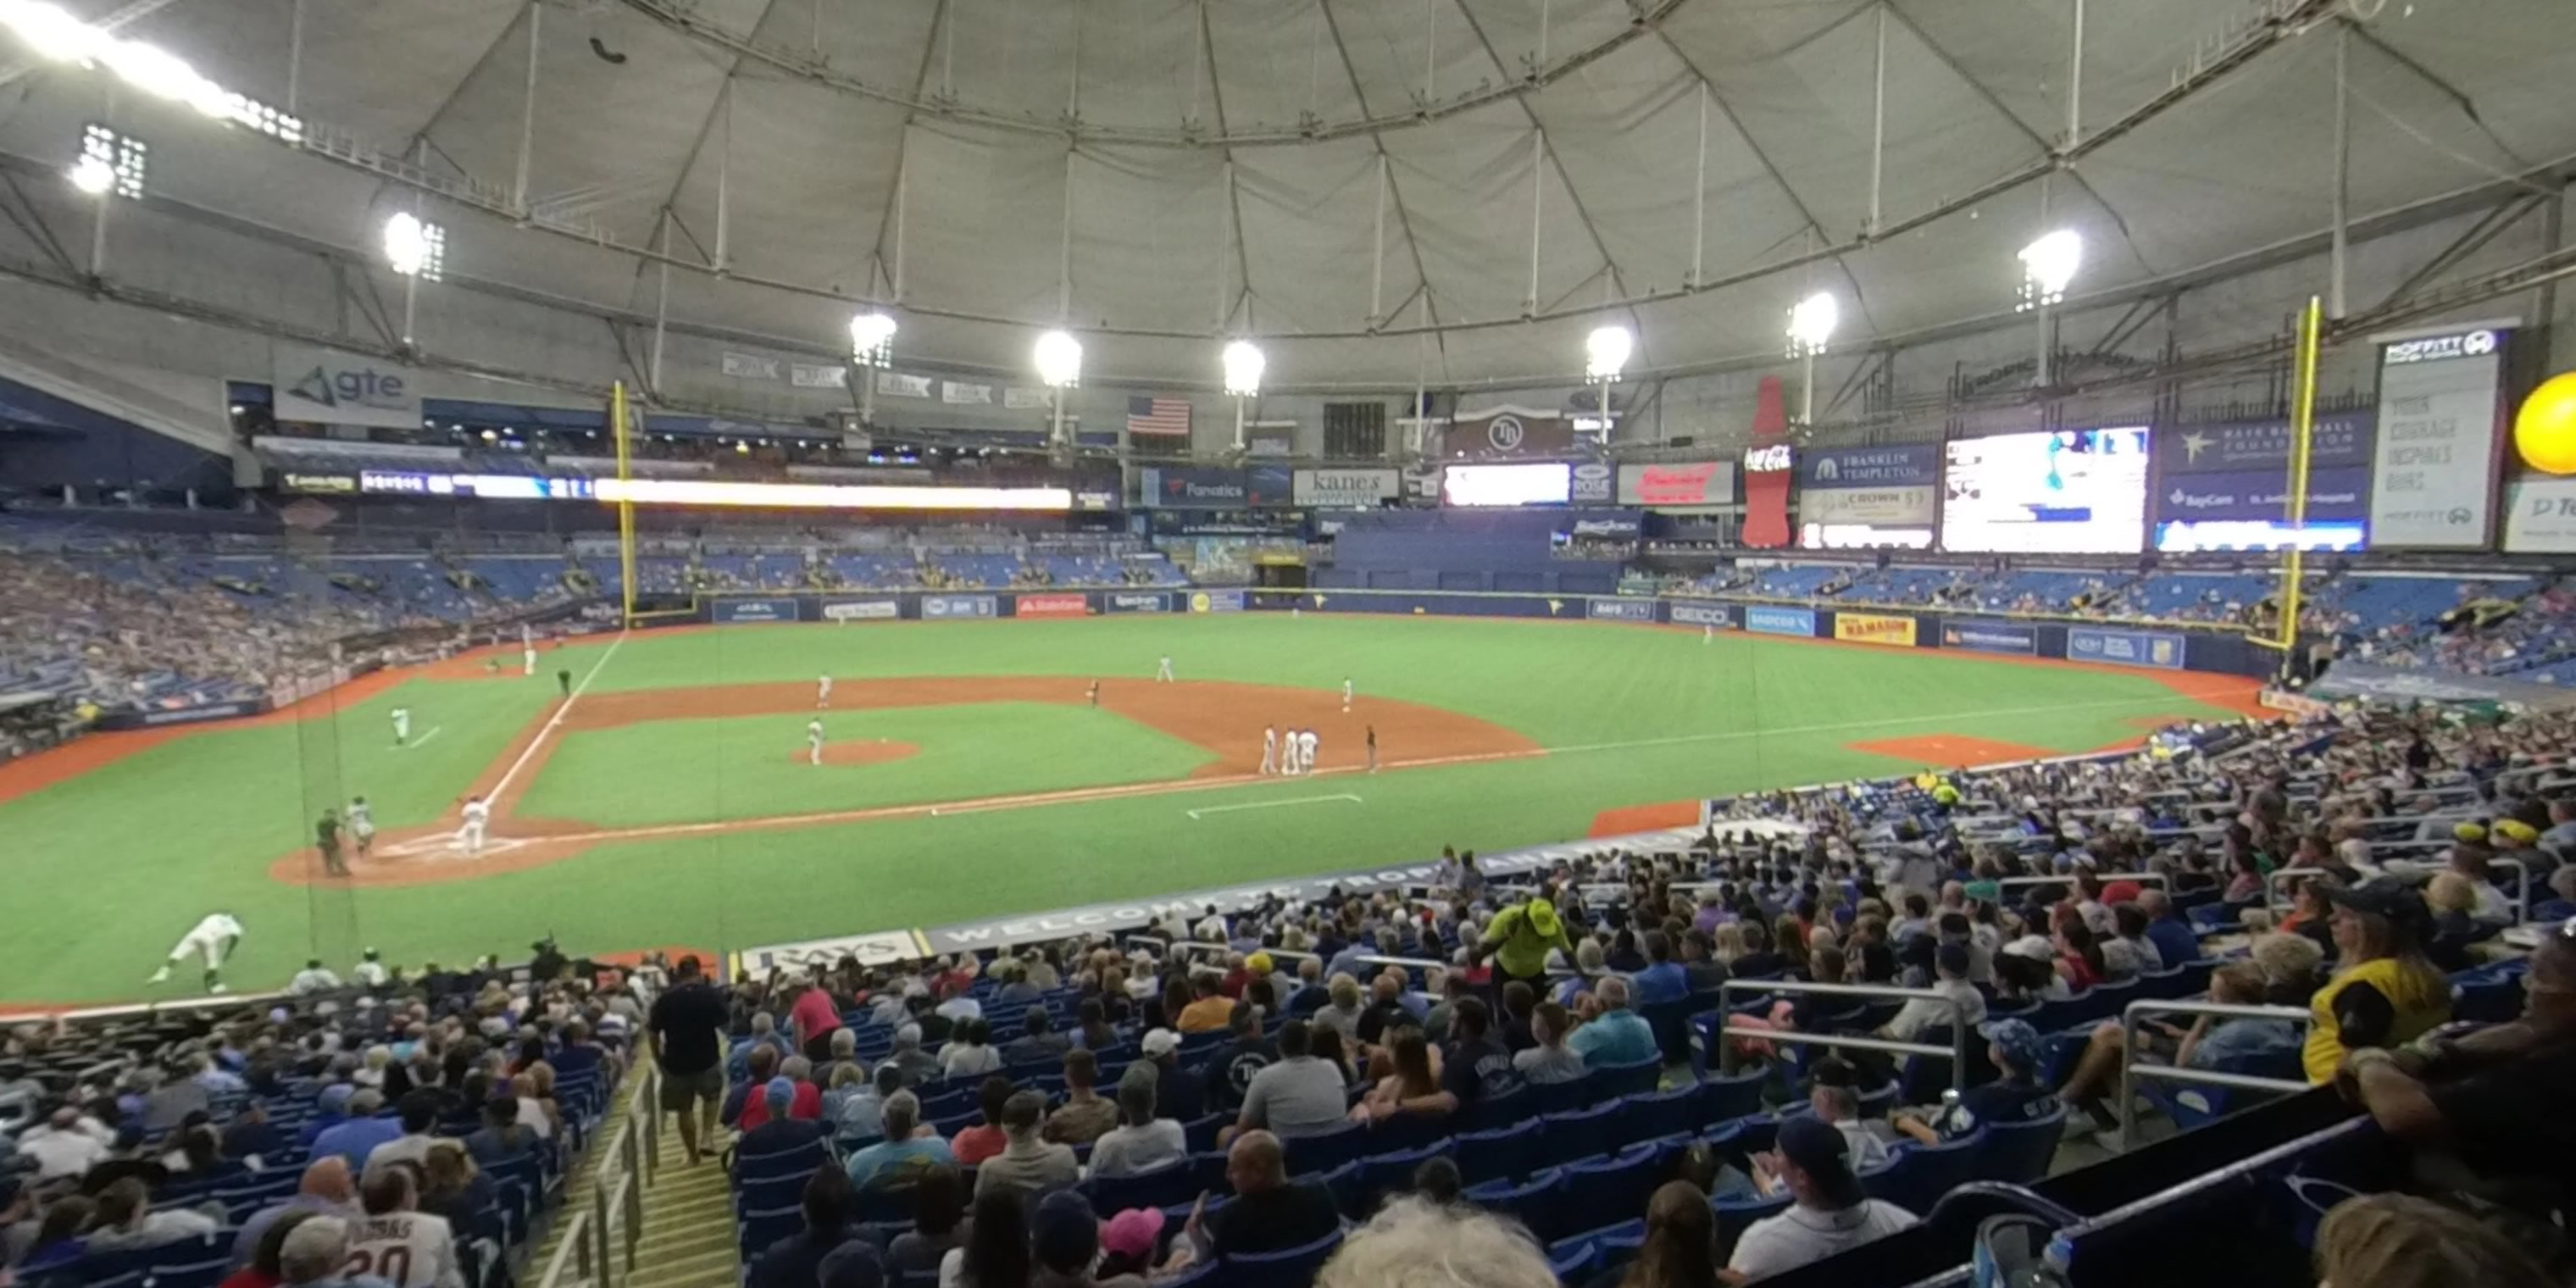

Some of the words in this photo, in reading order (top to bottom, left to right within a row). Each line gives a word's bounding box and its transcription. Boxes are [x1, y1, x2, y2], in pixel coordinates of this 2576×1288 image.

[337, 367, 403, 401] gte
[1842, 453, 1909, 468] FRANKLIN
[1313, 472, 1380, 491] kanes
[1842, 465, 1920, 480] TEMPLETON
[1187, 482, 1243, 497] Fanatics
[1672, 606, 1726, 625] GEICO
[945, 896, 1226, 943] WELCOME
